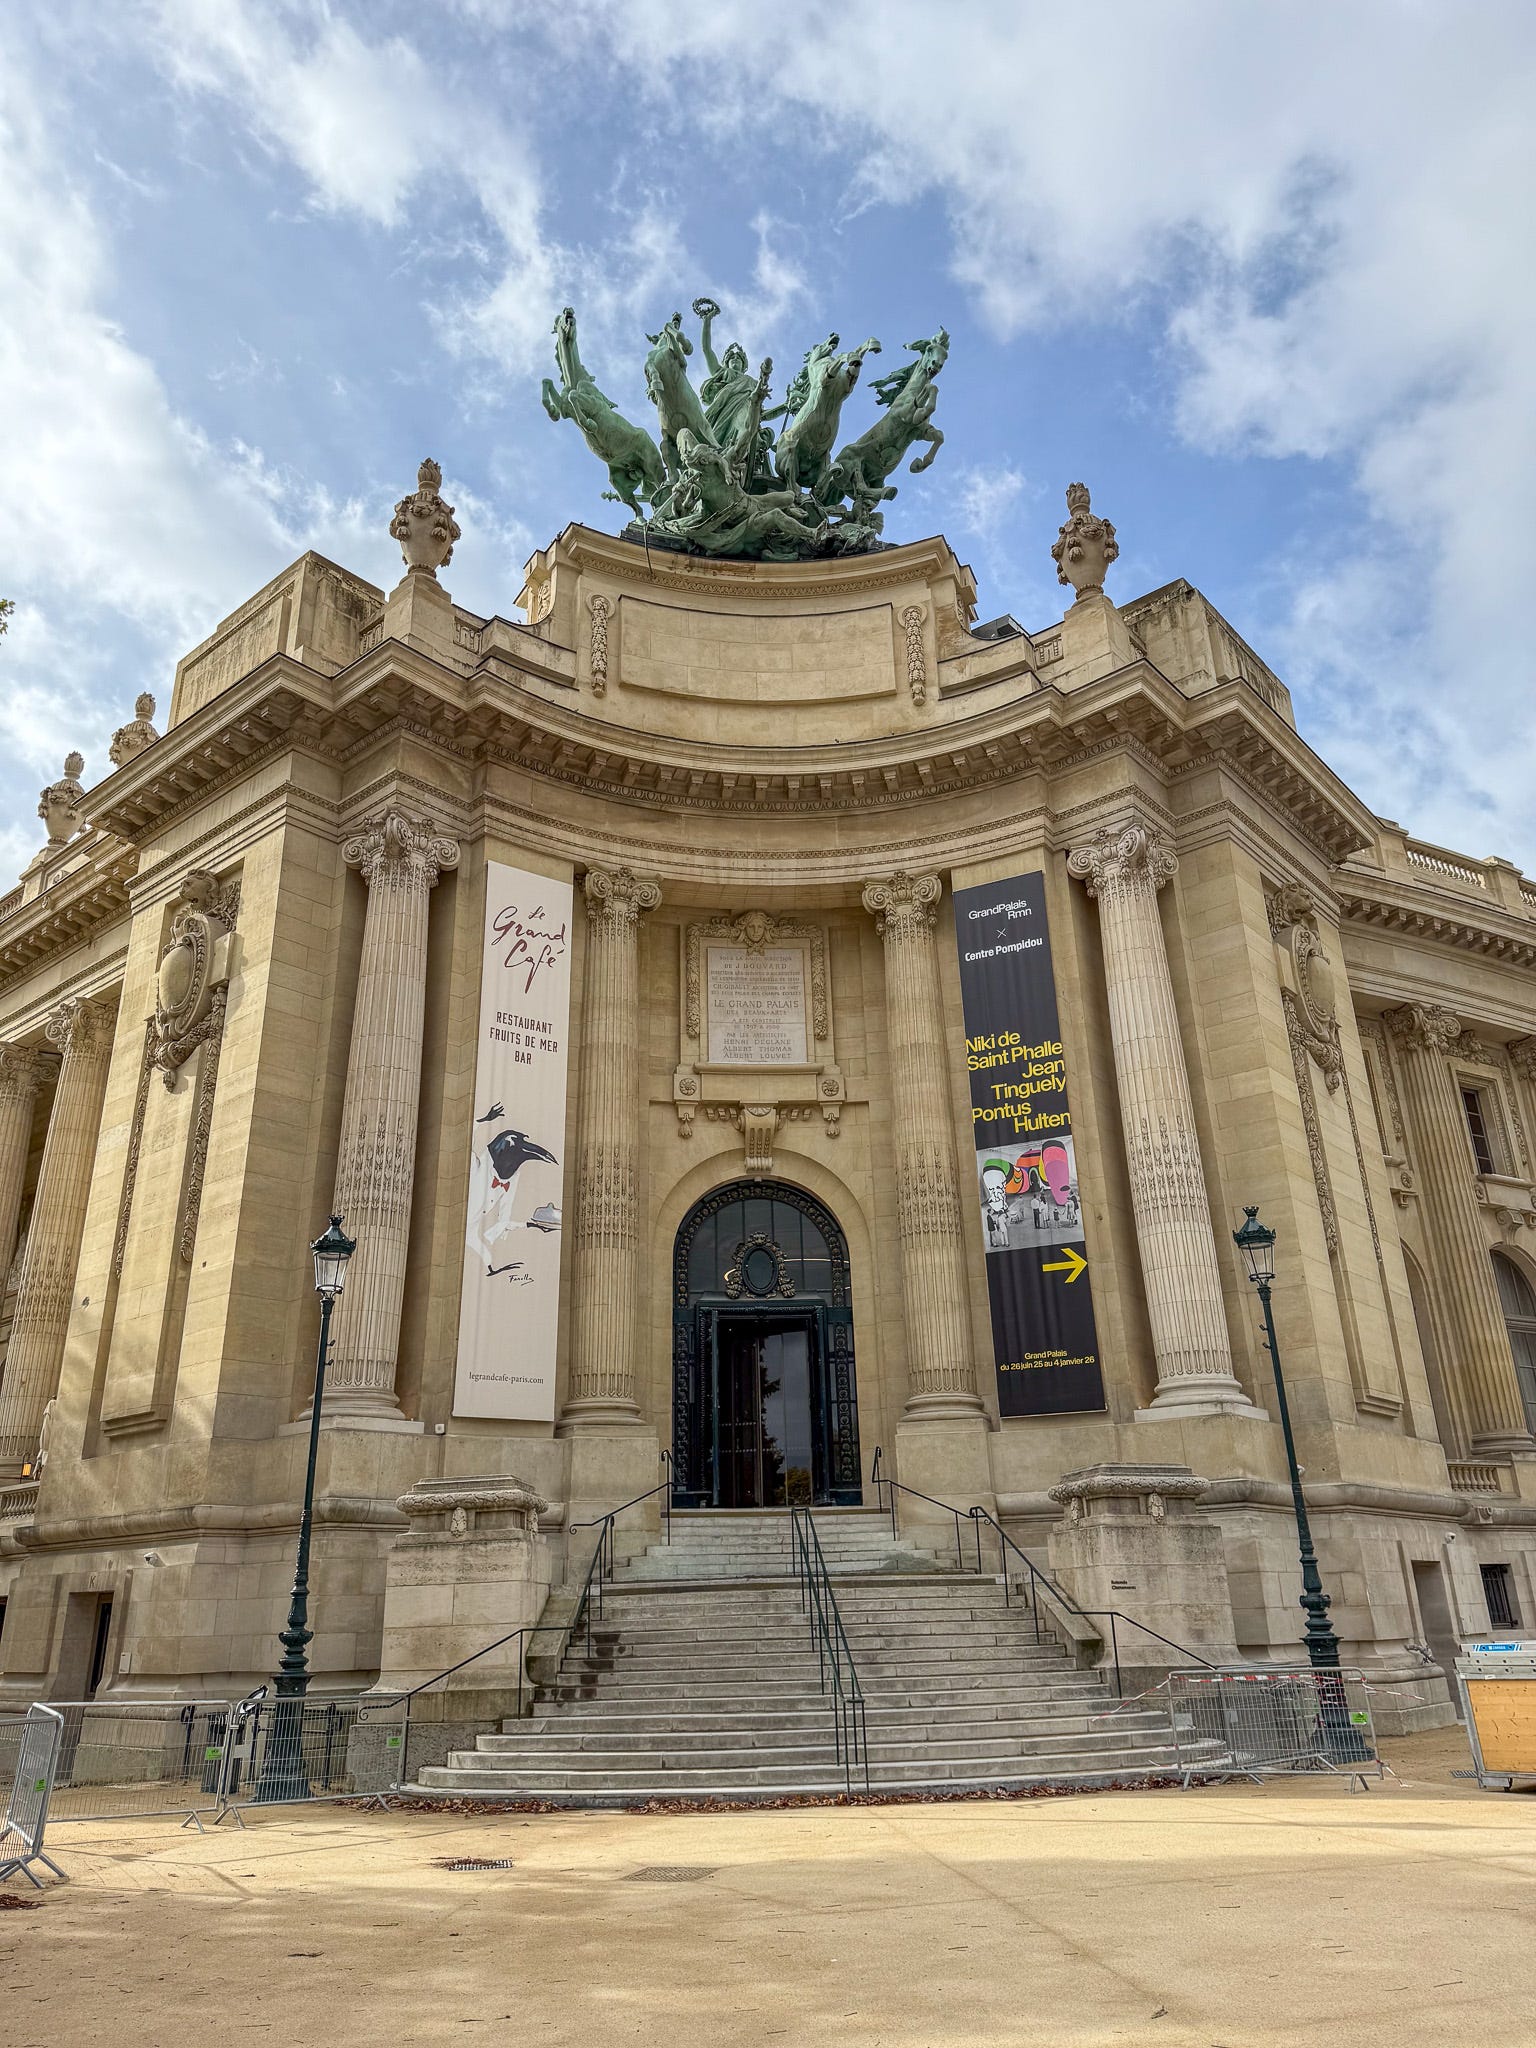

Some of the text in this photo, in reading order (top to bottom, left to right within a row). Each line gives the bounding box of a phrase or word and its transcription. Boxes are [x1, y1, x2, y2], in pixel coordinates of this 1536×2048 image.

[528, 906, 545, 919] Le
[968, 899, 1027, 920] GrandPalais
[1008, 908, 1031, 920] Rmn
[491, 906, 566, 945] Grand
[965, 938, 1043, 962] Centre Pompidou
[504, 939, 564, 994] Café
[497, 1012, 552, 1034] RESTAURANT
[490, 1027, 558, 1053] FRUITS DE MER
[966, 1031, 1020, 1054] Niki de
[515, 1051, 531, 1065] BAR
[967, 1040, 1063, 1071] Saint Phalle
[1022, 1059, 1065, 1079] Jean
[991, 1075, 1066, 1100] Tinguely
[972, 1102, 1031, 1124] Pontus
[1014, 1112, 1071, 1134] Hulten
[1000, 1363, 1009, 1371] du
[1020, 1362, 1032, 1371] juin
[1060, 1357, 1083, 1367] janvier
[1084, 1356, 1094, 1364] 26
[1024, 1349, 1067, 1360] Grand Palais
[469, 1372, 543, 1384] legrandcafe-paris.com
